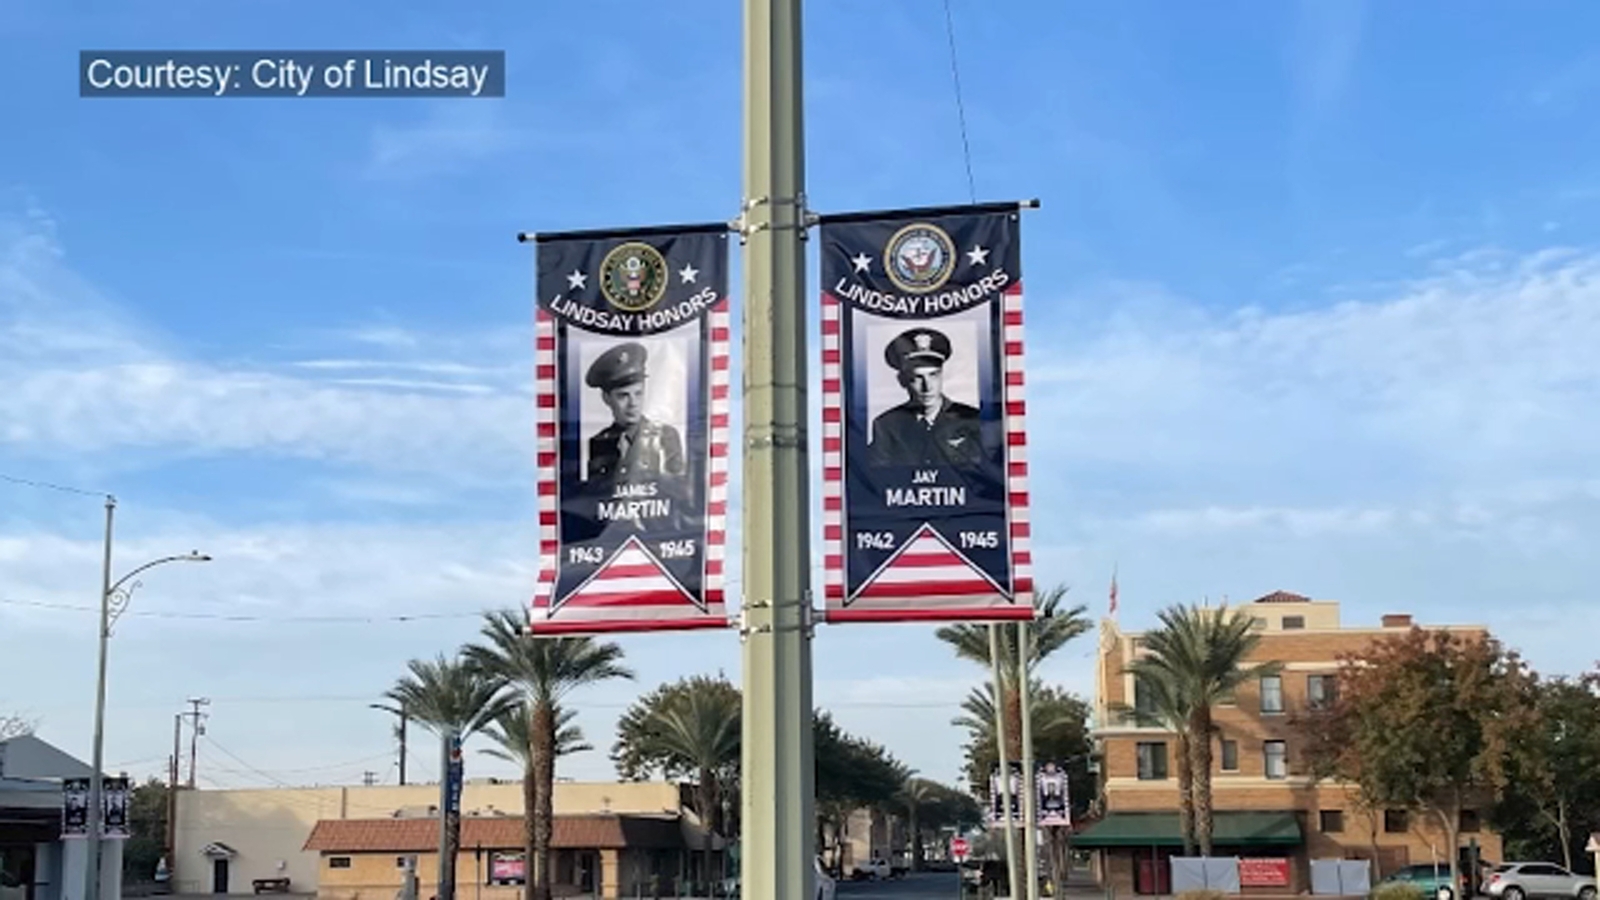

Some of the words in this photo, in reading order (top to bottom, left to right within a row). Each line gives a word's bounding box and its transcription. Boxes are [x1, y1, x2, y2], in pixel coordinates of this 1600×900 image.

[835, 277, 920, 314] LINDSAY
[924, 267, 1009, 312] HONORS
[550, 294, 633, 331] LINDSAY
[638, 286, 717, 329] HONORS
[911, 470, 939, 484] JAY
[612, 482, 658, 499] JAMES
[886, 487, 966, 507] MARTIN
[598, 499, 670, 521] MARTIN
[659, 539, 695, 558] 1945
[856, 532, 895, 549] 1942
[960, 531, 998, 548] 1945
[569, 546, 604, 564] 1943
